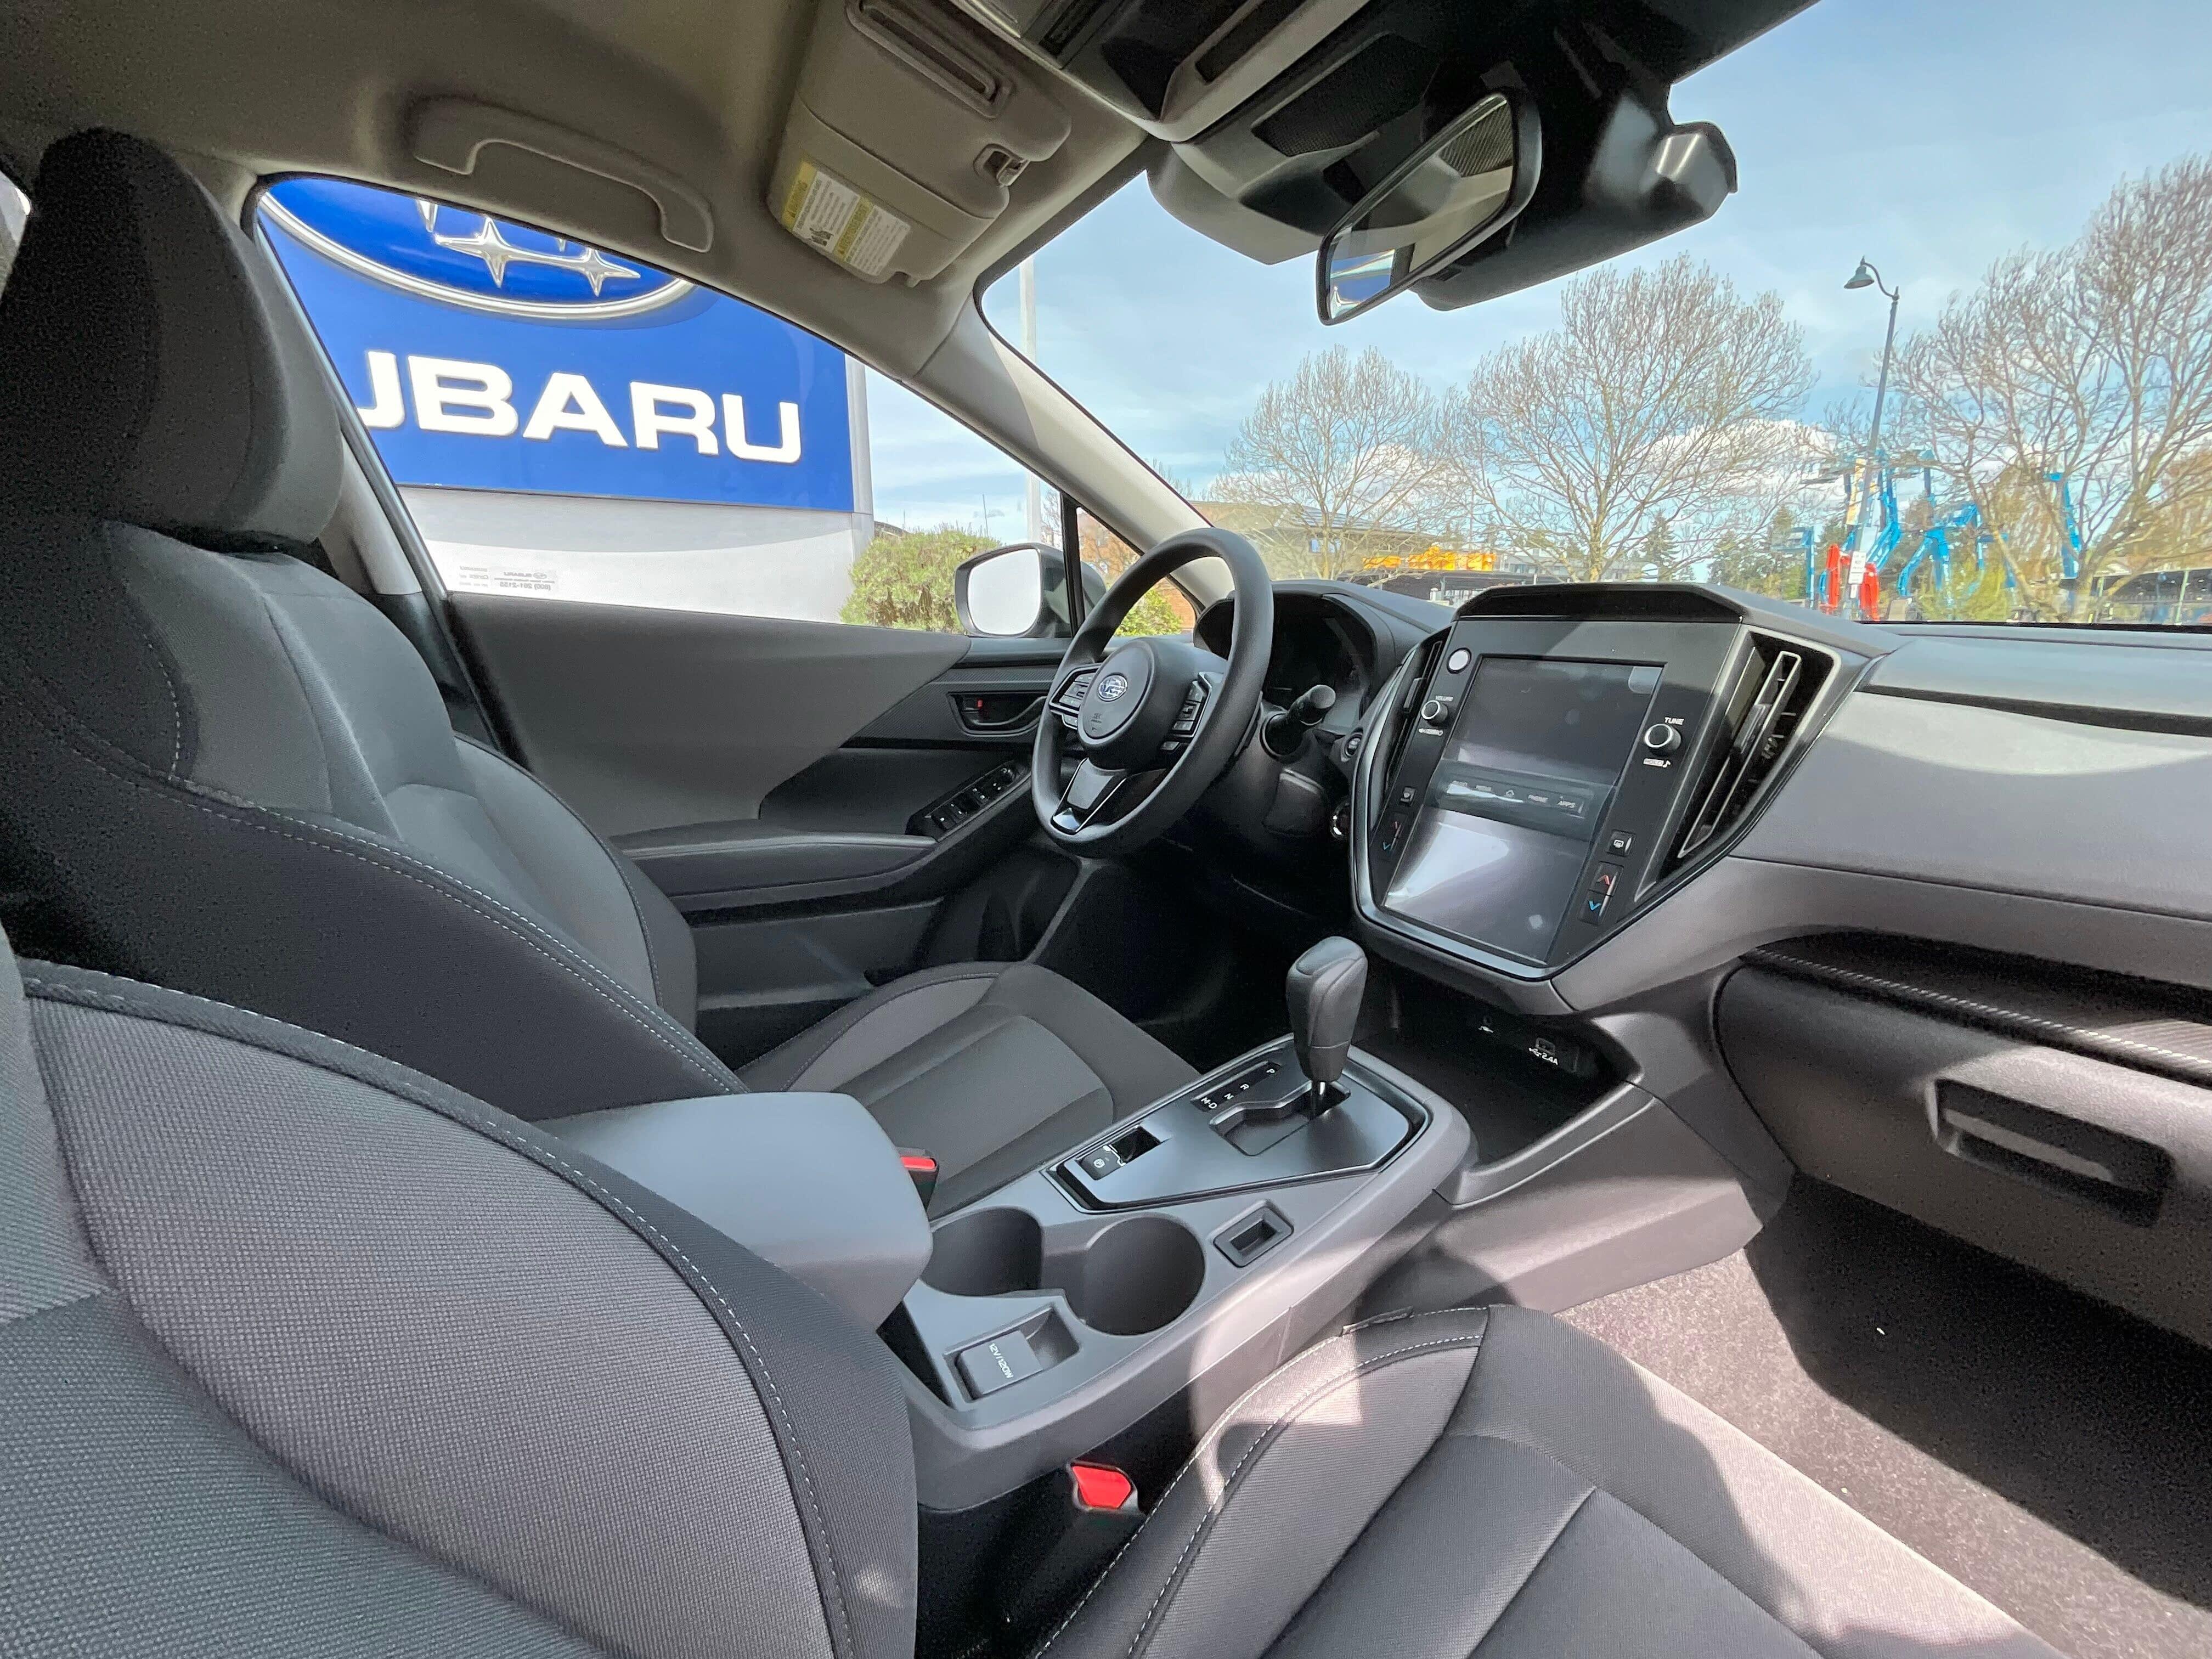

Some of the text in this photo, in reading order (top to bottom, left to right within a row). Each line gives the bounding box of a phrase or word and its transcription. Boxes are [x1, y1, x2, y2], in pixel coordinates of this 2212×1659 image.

[1664, 716, 1684, 725] TUNE
[1542, 1052, 1558, 1065] 2.4A
[989, 1342, 1014, 1379] 12V/120W
